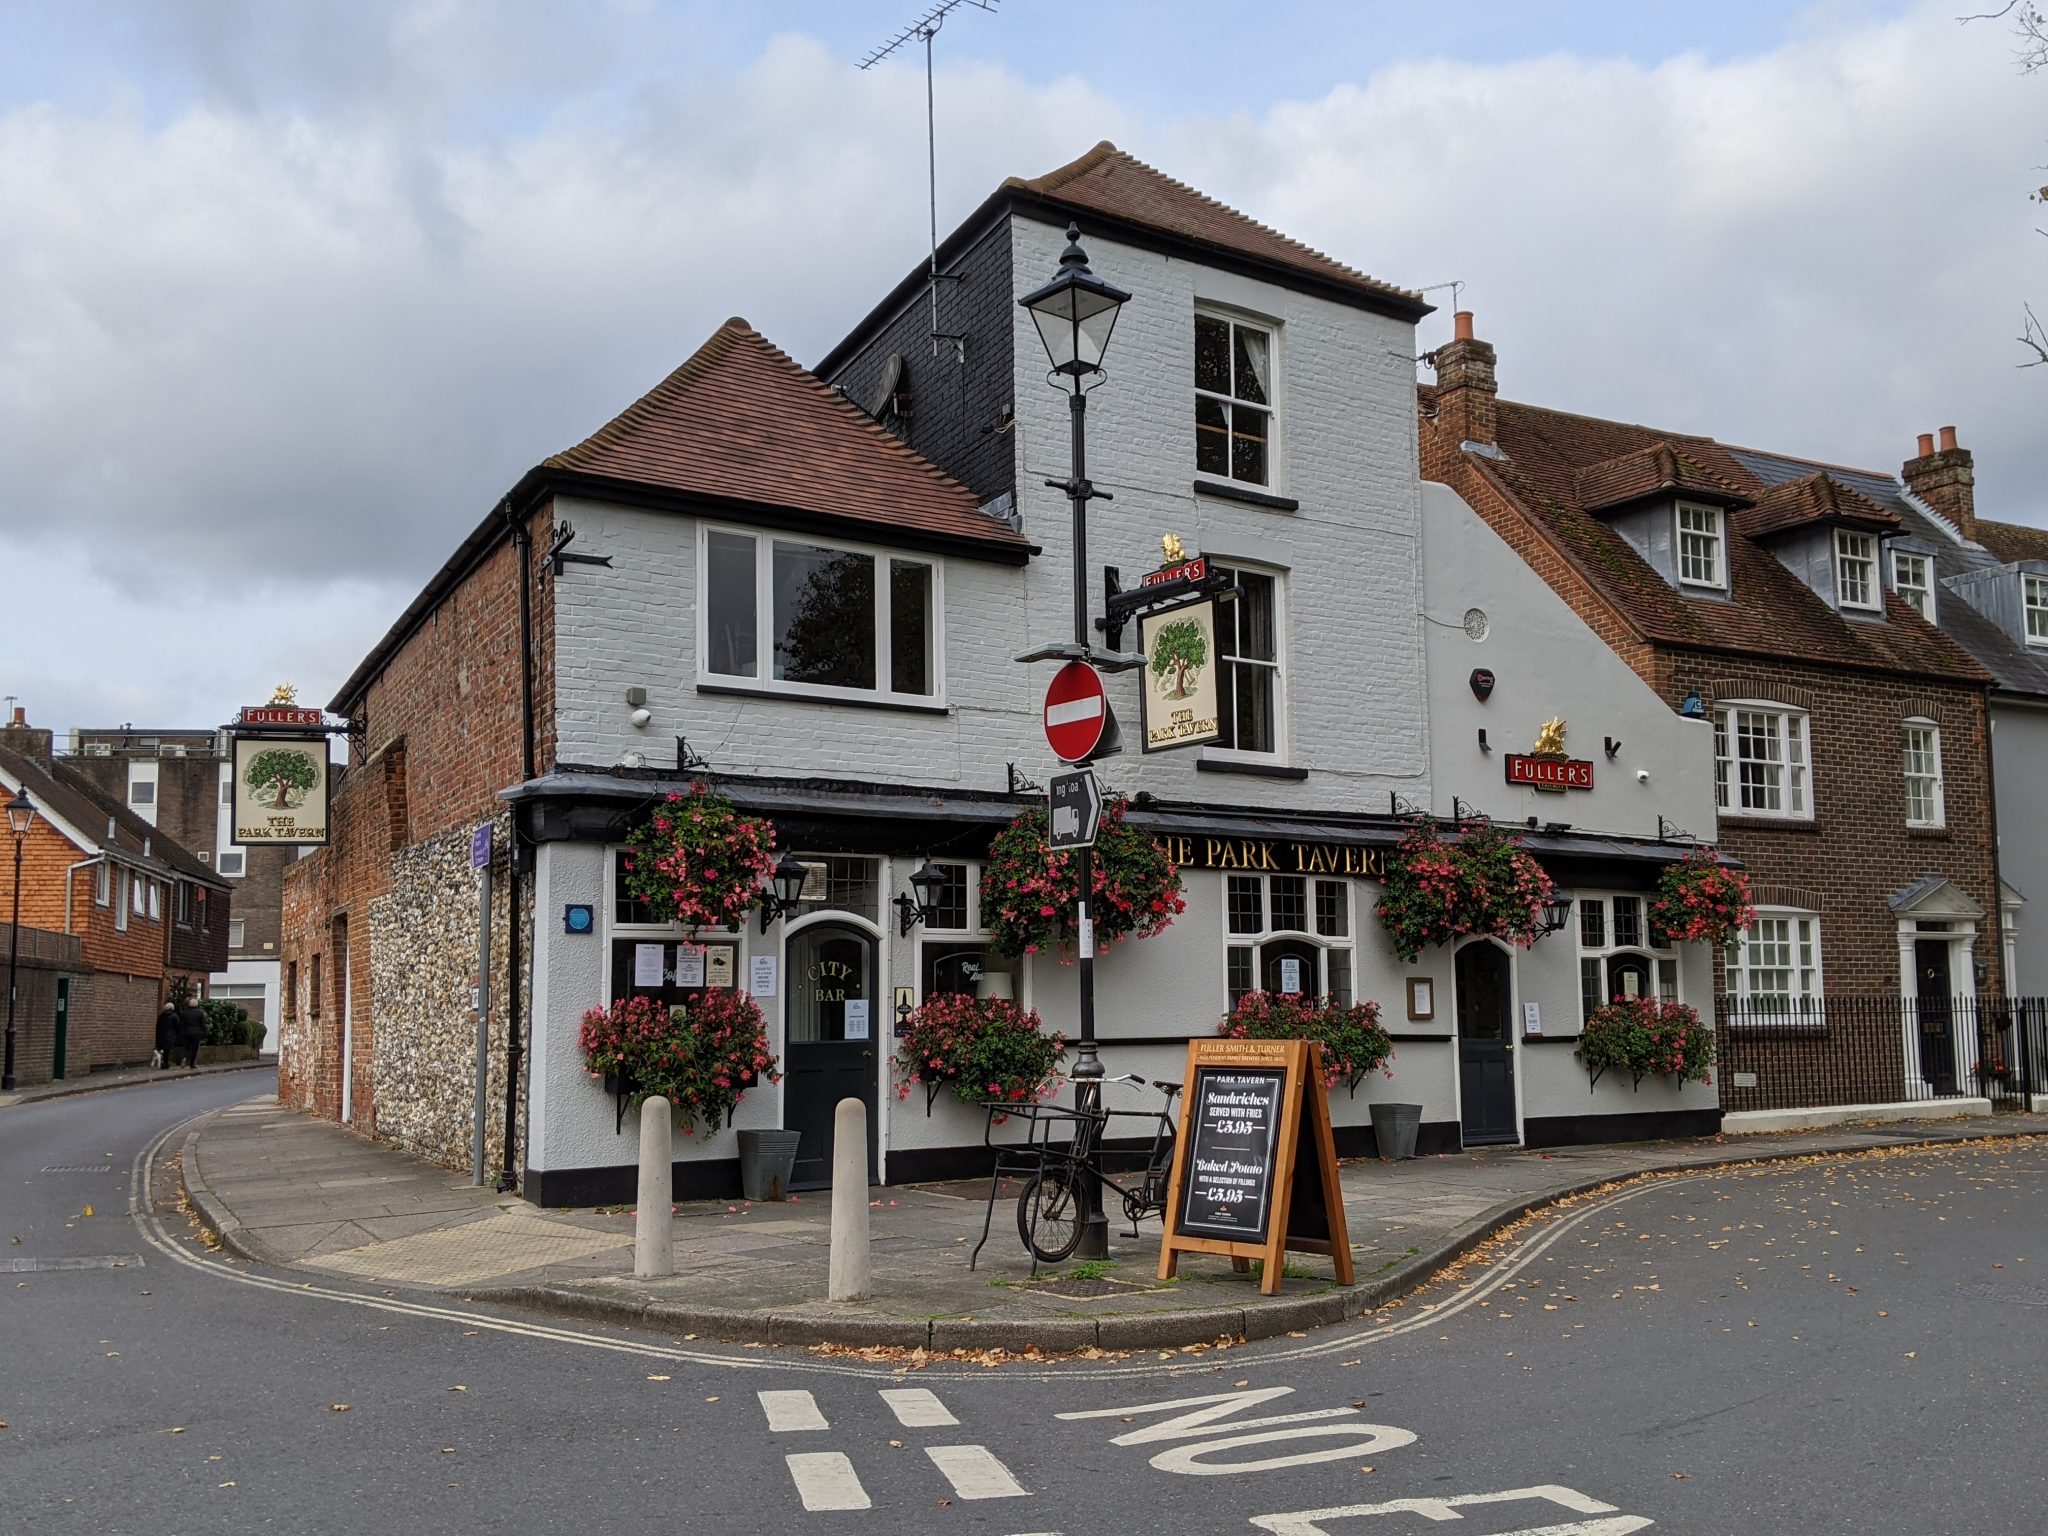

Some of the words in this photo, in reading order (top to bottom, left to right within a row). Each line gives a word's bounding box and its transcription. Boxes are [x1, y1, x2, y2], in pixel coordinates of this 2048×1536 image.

[246, 709, 316, 724] FULLER'S
[1171, 708, 1194, 725] THE
[1149, 724, 1175, 743] PARK
[1177, 717, 1218, 738] TAVERN
[1514, 759, 1588, 784] FULLER'S
[267, 816, 295, 827] THE
[238, 828, 272, 838] PARK
[275, 828, 325, 838] TAVERN
[1205, 838, 1280, 870] PARK
[807, 961, 852, 981] CITY
[961, 961, 982, 974] Real
[969, 972, 984, 981] Ales
[815, 988, 846, 1002] BAR
[1200, 1045, 1225, 1053] FULLER
[1225, 1045, 1248, 1053] SMITH
[1249, 1045, 1256, 1053] &
[1257, 1045, 1285, 1053] TURNER
[1216, 1076, 1235, 1084] PARK
[1237, 1076, 1265, 1084] TAVERN
[1206, 1091, 1269, 1106] Sandwiches
[1209, 1106, 1230, 1117] SERVED
[1230, 1107, 1245, 1118] WITH
[1246, 1108, 1262, 1118] FRIES
[1196, 1158, 1228, 1172] Baked
[1228, 1161, 1263, 1174] Potato
[1198, 1175, 1209, 1183] WITH
[1213, 1176, 1232, 1185] SELECTION
[1232, 1177, 1238, 1185] OF
[1238, 1178, 1256, 1187] FILLINGS
[1054, 1386, 1419, 1476] NO
